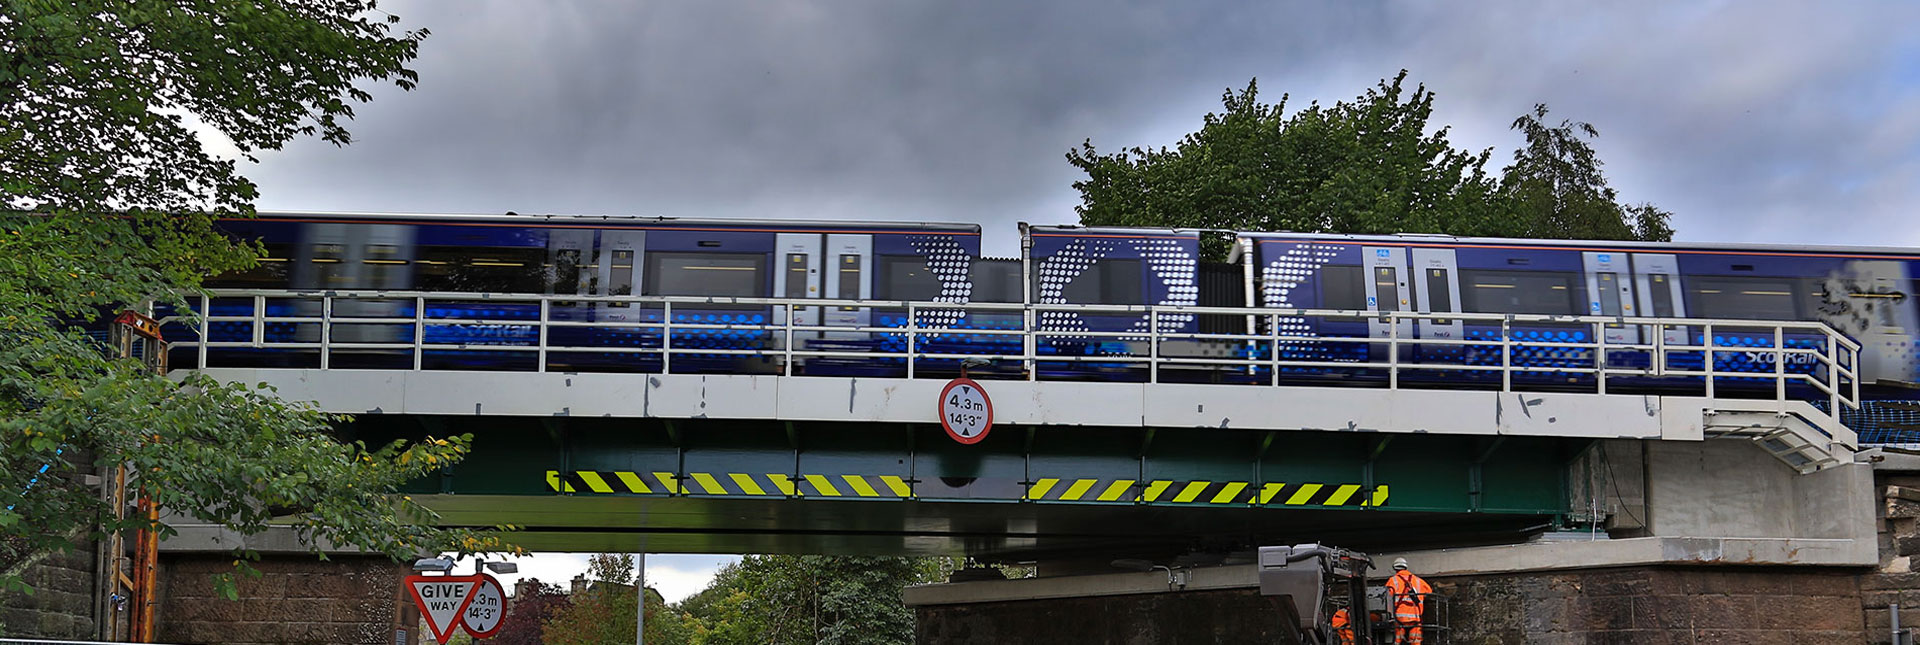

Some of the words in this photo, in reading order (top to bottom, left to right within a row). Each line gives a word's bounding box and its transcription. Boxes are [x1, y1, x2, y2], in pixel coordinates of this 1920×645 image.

[1745, 351, 1817, 365] ScoRail
[421, 584, 464, 598] GIVE
[430, 601, 457, 611] WAY
